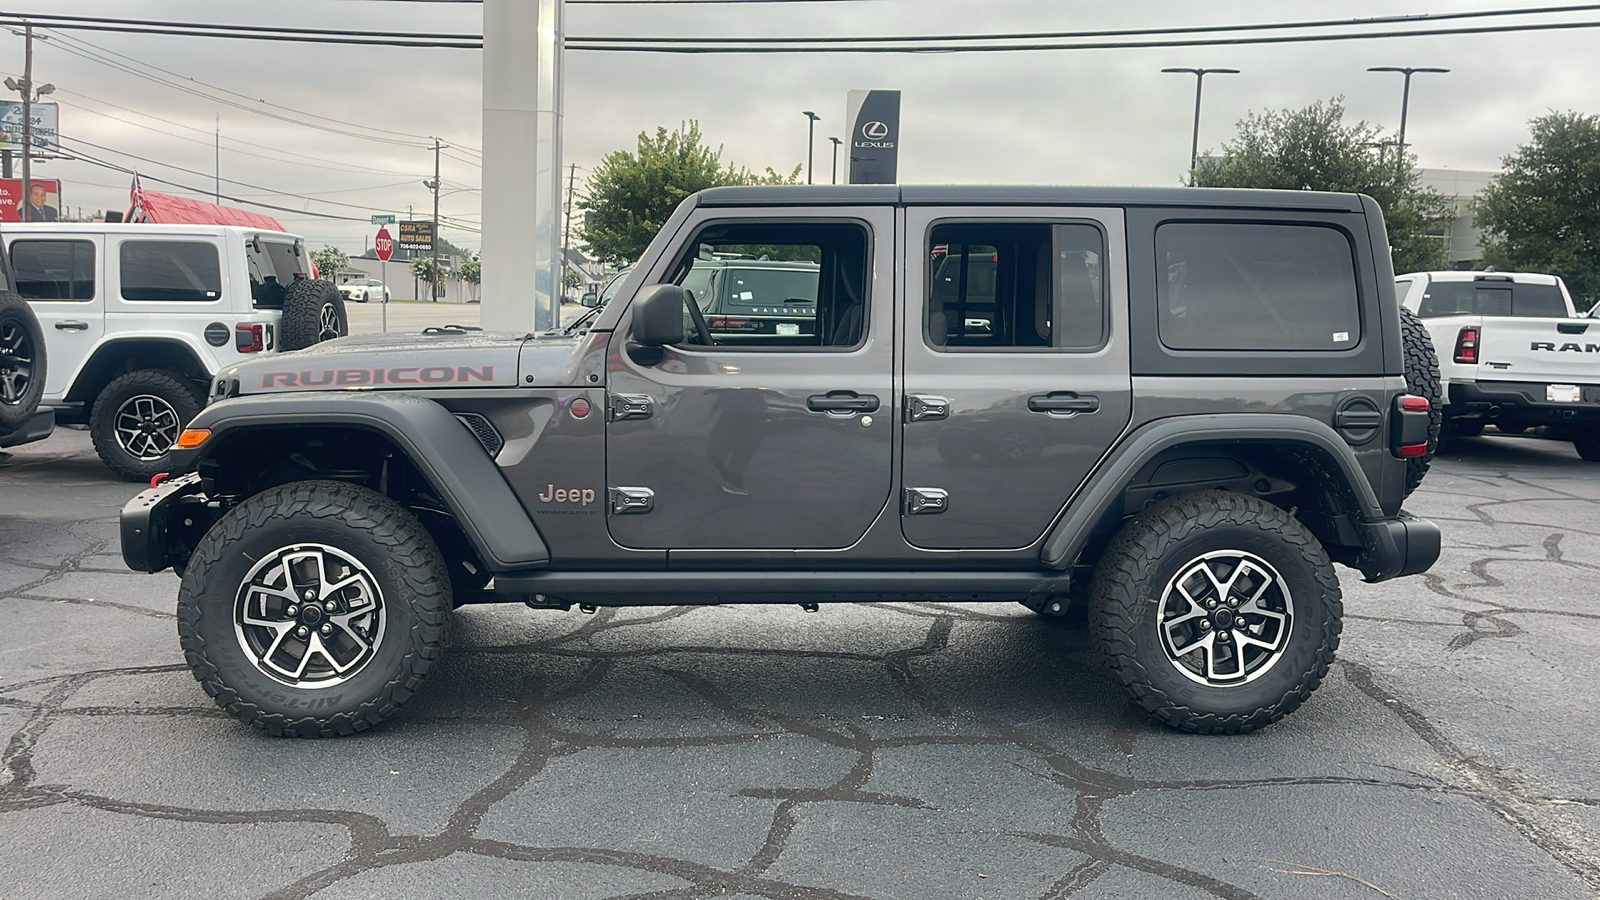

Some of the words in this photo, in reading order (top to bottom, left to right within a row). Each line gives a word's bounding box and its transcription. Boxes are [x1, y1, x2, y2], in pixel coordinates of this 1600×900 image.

[18, 117, 42, 125] 224
[854, 141, 895, 149] LEXUS
[377, 238, 392, 252] STOP
[1530, 341, 1600, 353] RAM
[262, 365, 495, 389] RUBICON
[538, 482, 596, 507] Jeep
